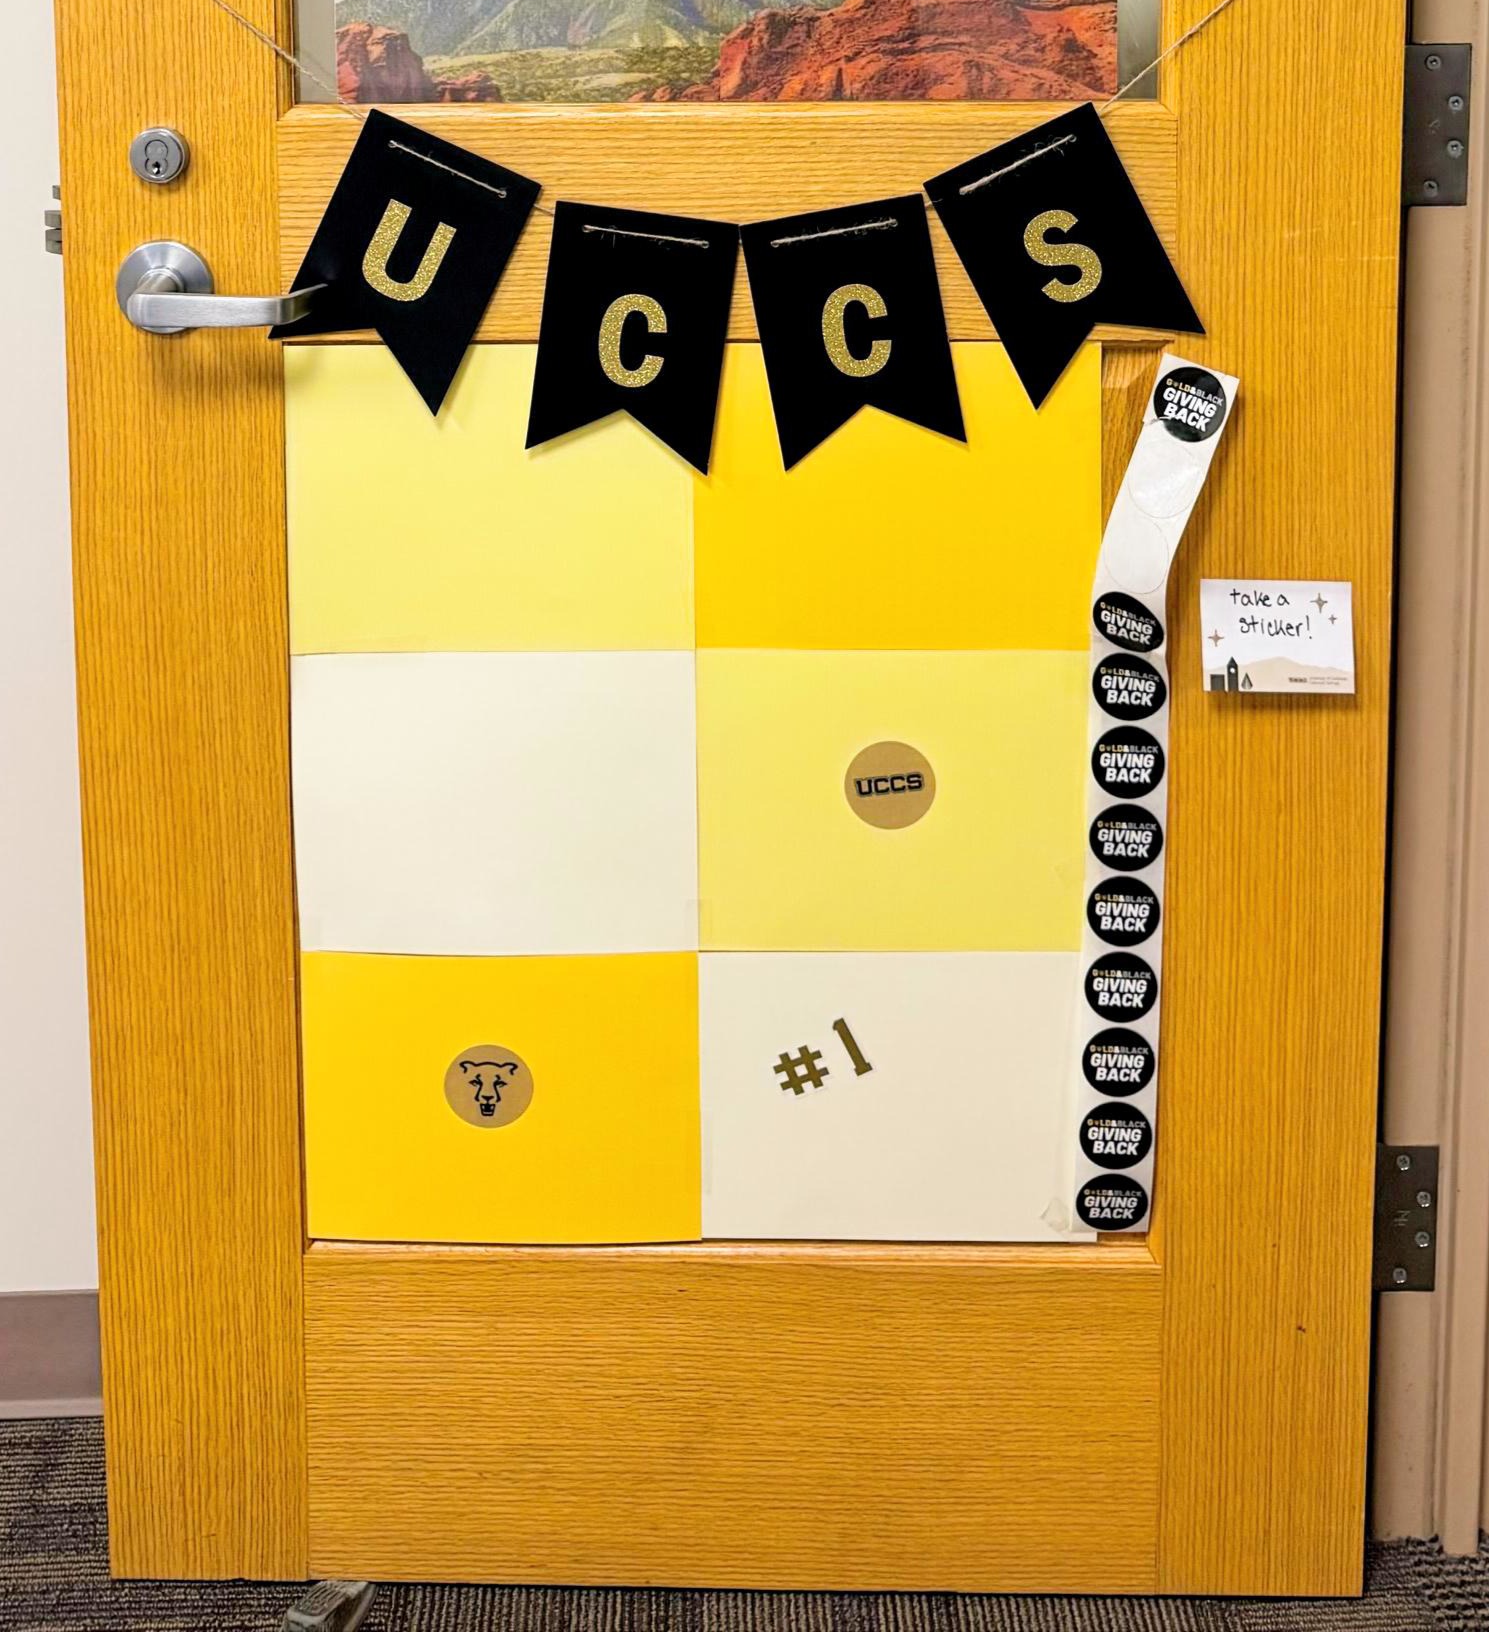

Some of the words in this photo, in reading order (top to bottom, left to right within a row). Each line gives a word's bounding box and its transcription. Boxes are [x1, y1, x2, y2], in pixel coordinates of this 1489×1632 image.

[1163, 387, 1217, 418] GIVING
[1164, 402, 1210, 432] BACK
[1230, 588, 1272, 608] take
[1276, 593, 1290, 607] a
[1101, 610, 1153, 634] GIVING
[1239, 615, 1312, 639] sticker!
[1106, 623, 1152, 645] BACK
[1101, 675, 1156, 693] GIVING
[1106, 689, 1153, 707] BACK
[1100, 753, 1155, 769] GIVING
[1105, 768, 1152, 784] BACK
[855, 773, 923, 796] UCCS
[1097, 829, 1153, 844] GIVING
[1102, 842, 1150, 858] BACK
[1095, 902, 1150, 918] GIVING
[1100, 916, 1148, 932] BACK
[1092, 978, 1147, 993] GIVING
[1098, 992, 1145, 1008] BACK
[773, 1018, 873, 1096] #1
[1090, 1053, 1145, 1069] GIVING
[1095, 1067, 1142, 1083] BACK
[1087, 1126, 1142, 1142] GIVING
[1092, 1140, 1140, 1156] BACK
[1084, 1196, 1138, 1209] GIVING
[1089, 1207, 1135, 1219] BACK
